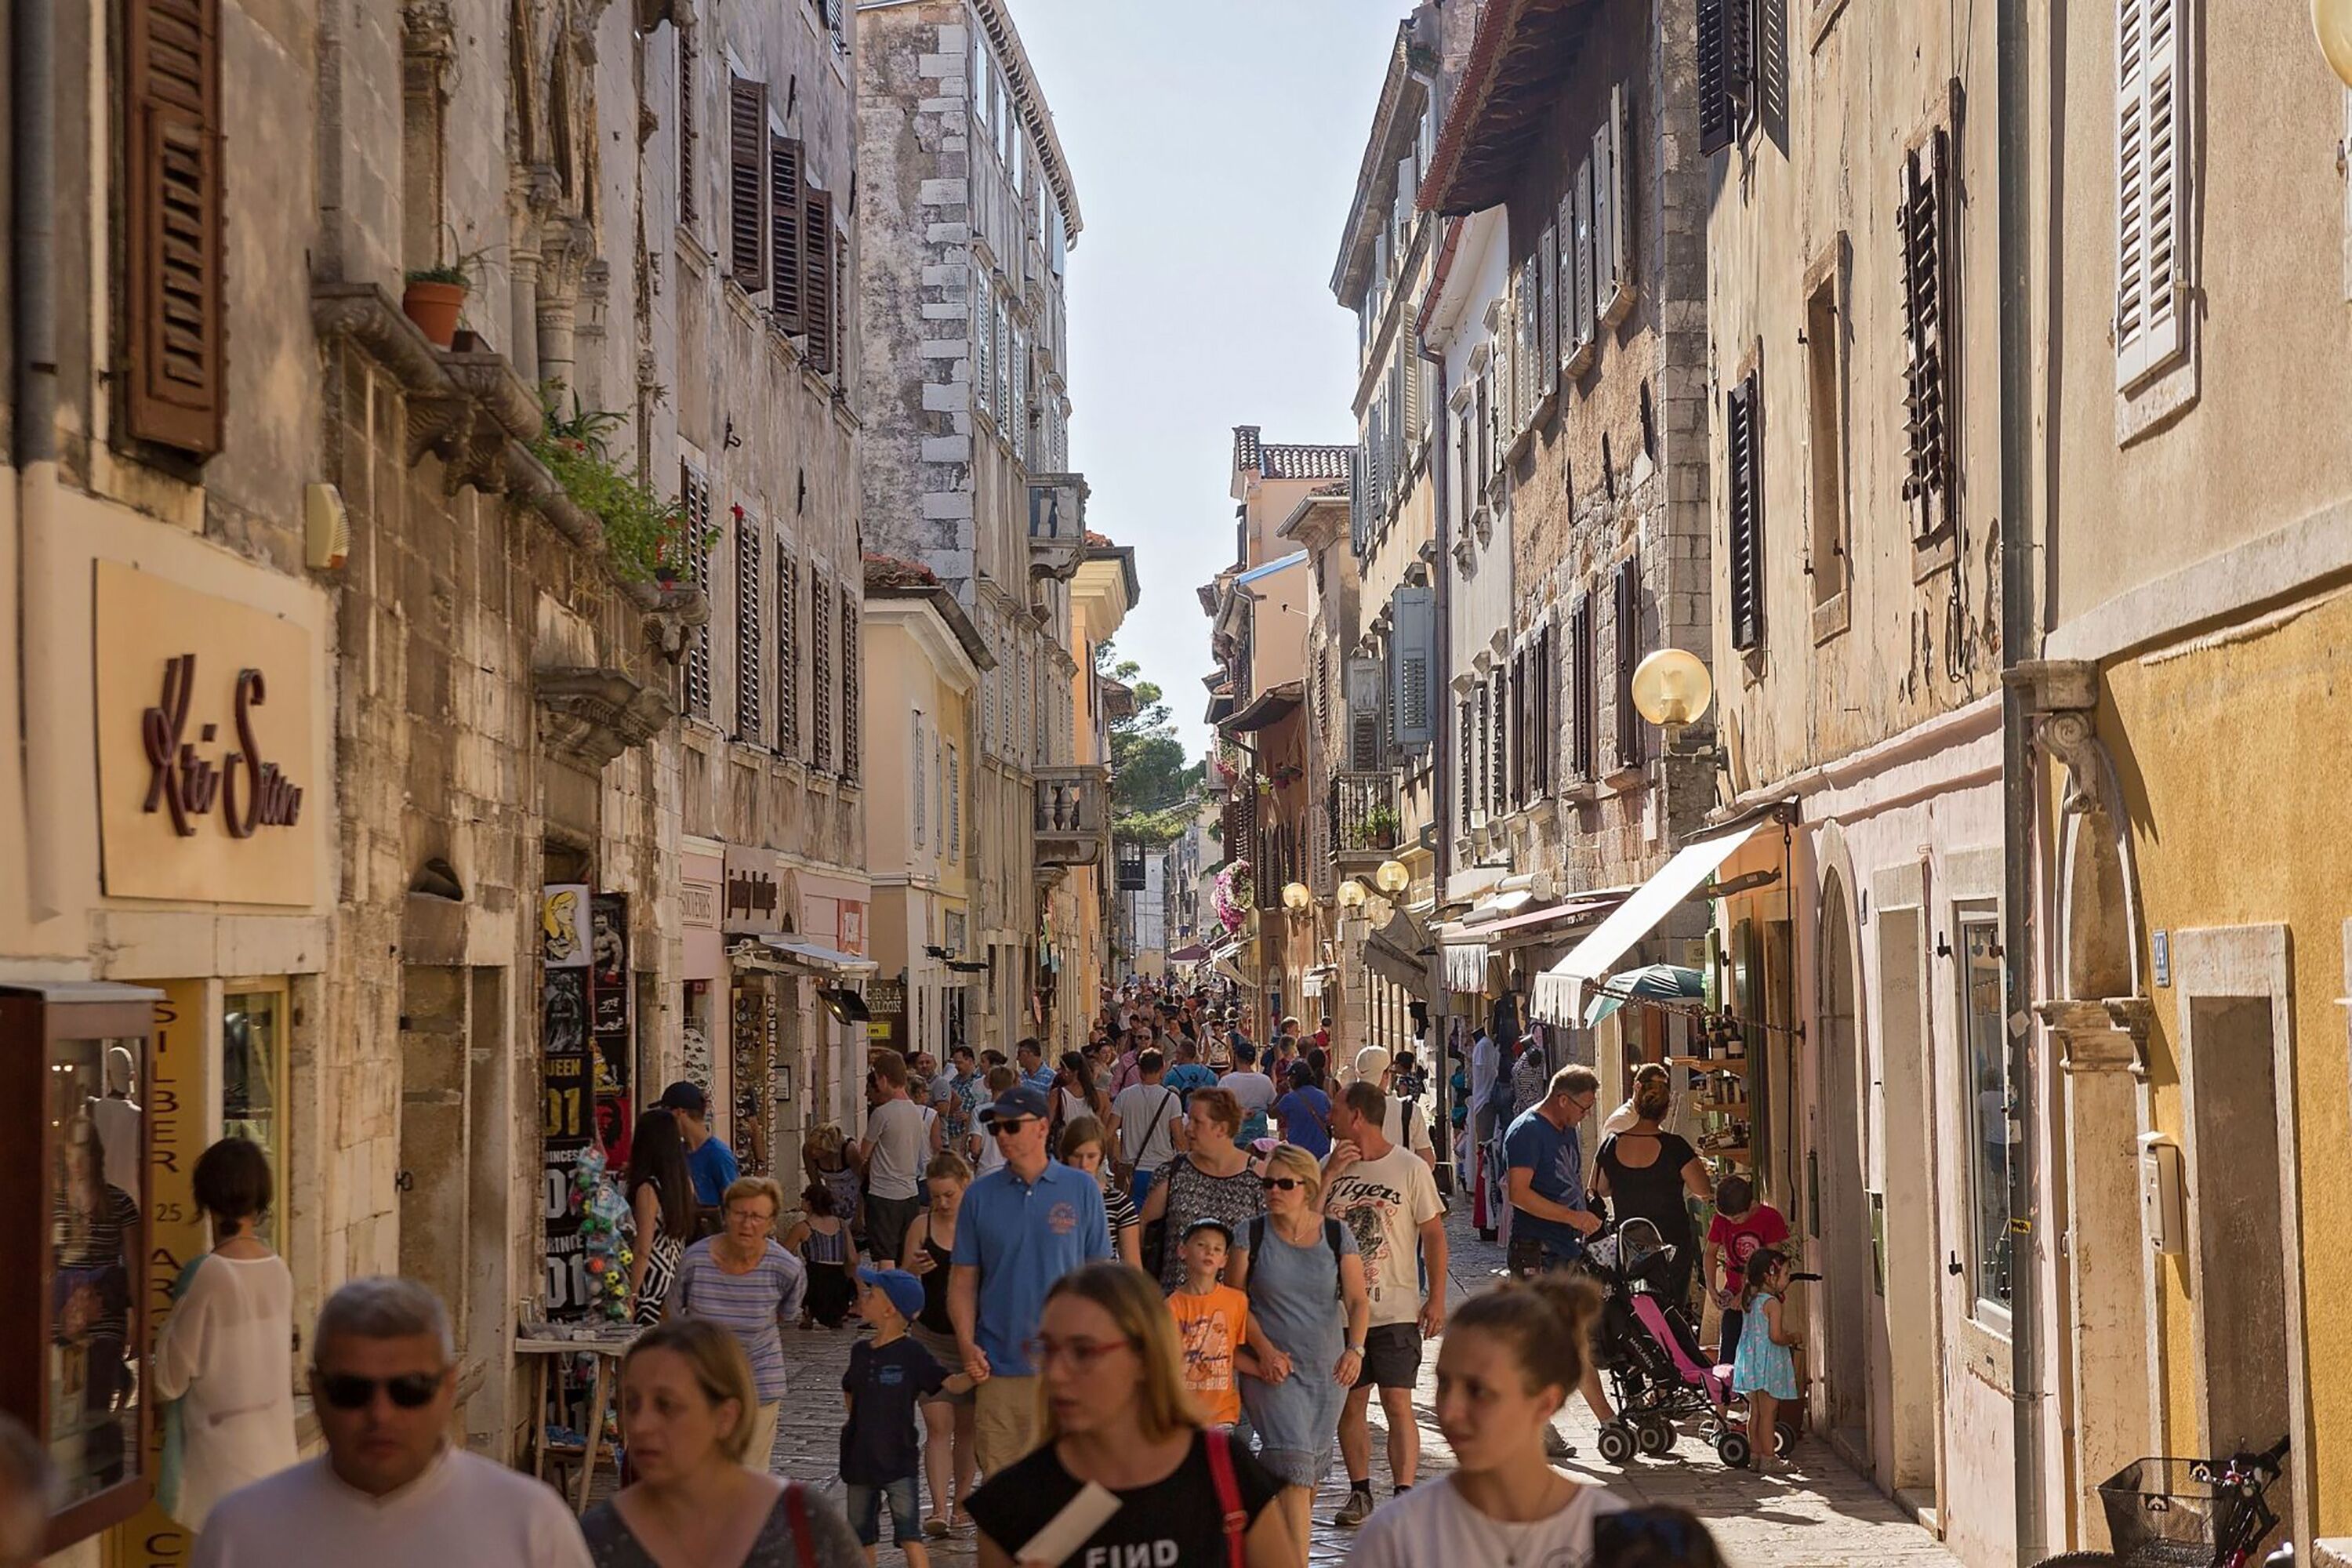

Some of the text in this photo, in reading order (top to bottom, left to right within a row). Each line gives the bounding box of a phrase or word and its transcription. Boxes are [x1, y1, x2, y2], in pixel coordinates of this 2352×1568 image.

[546, 1058, 581, 1076] UEEN
[1325, 1175, 1402, 1206] Tigers
[547, 1234, 584, 1253] RINCE
